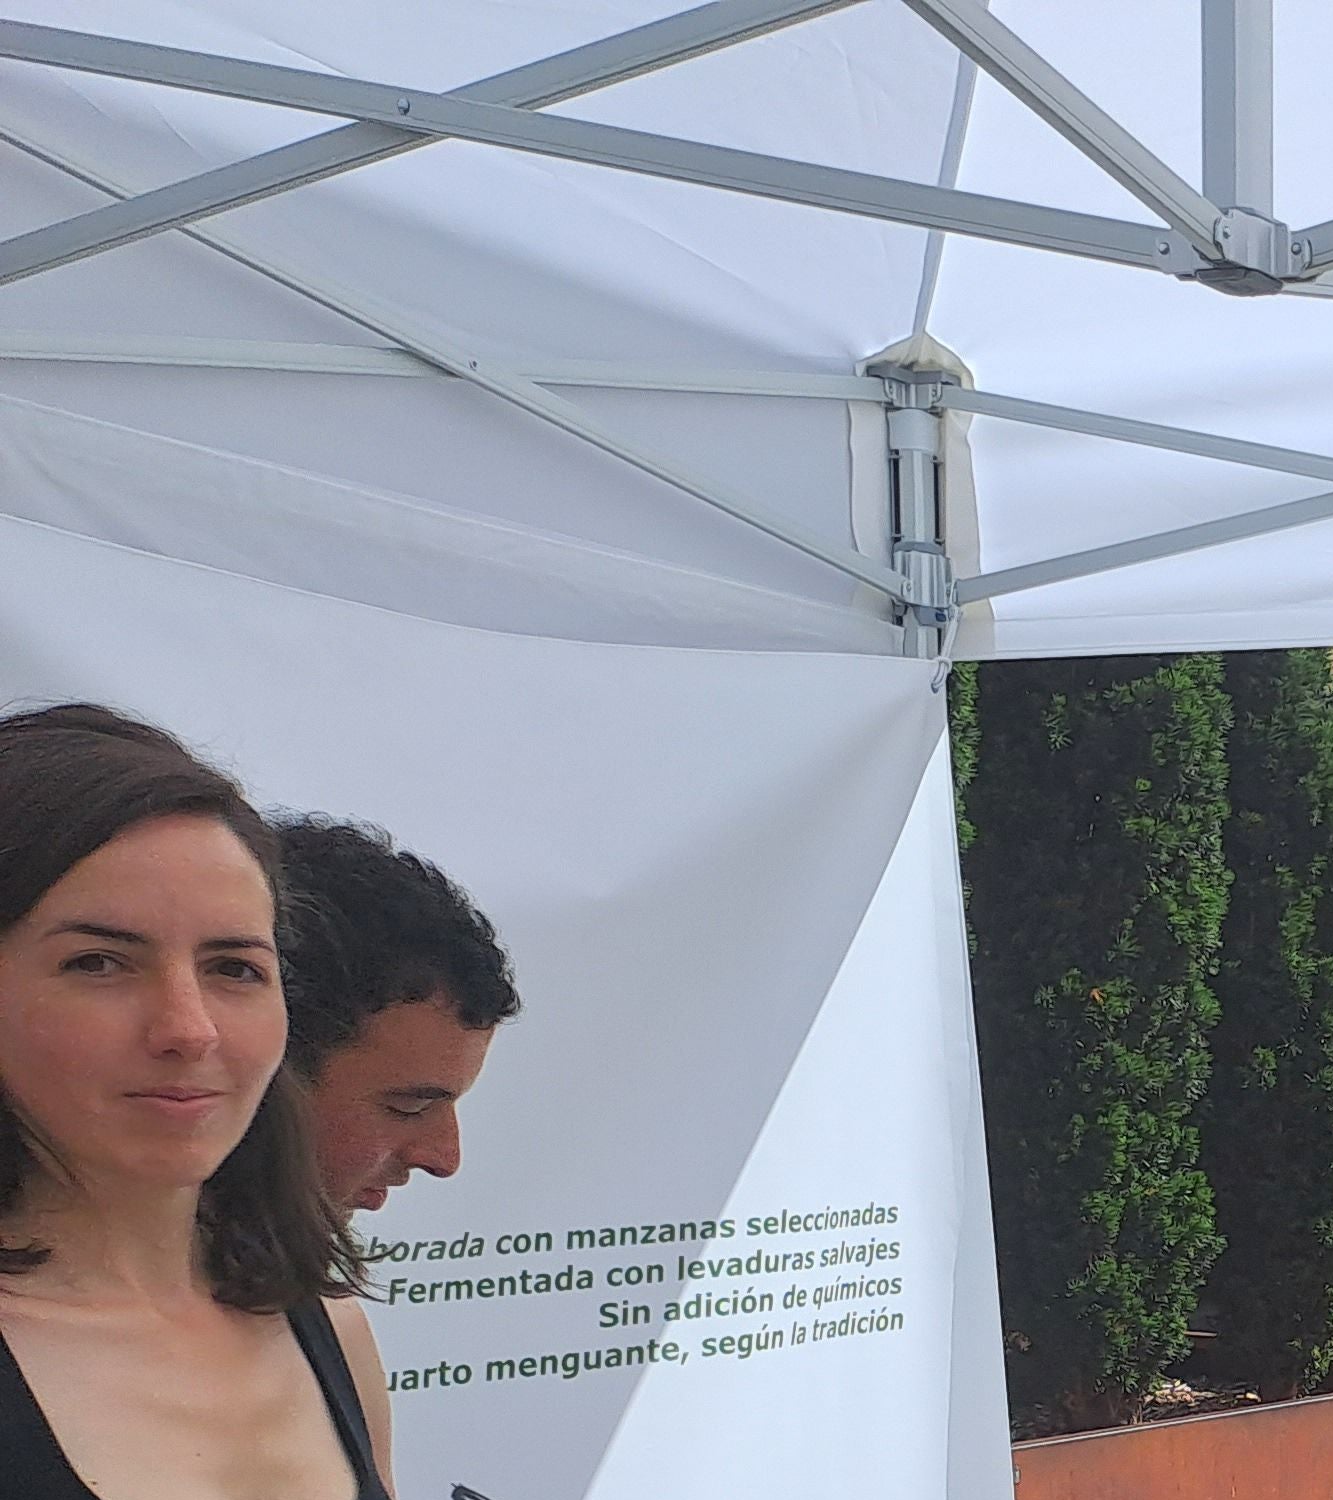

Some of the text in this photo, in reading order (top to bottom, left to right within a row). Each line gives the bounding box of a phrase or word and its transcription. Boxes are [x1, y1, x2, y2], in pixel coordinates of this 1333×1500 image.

[367, 1201, 899, 1264] borada con manzanas seleccionadas
[388, 1237, 901, 1306] Fermentada con levaduras salvajes
[599, 1275, 903, 1329] Sin adición de químicos
[386, 1306, 904, 1392] uarto menguante, según la tradición
